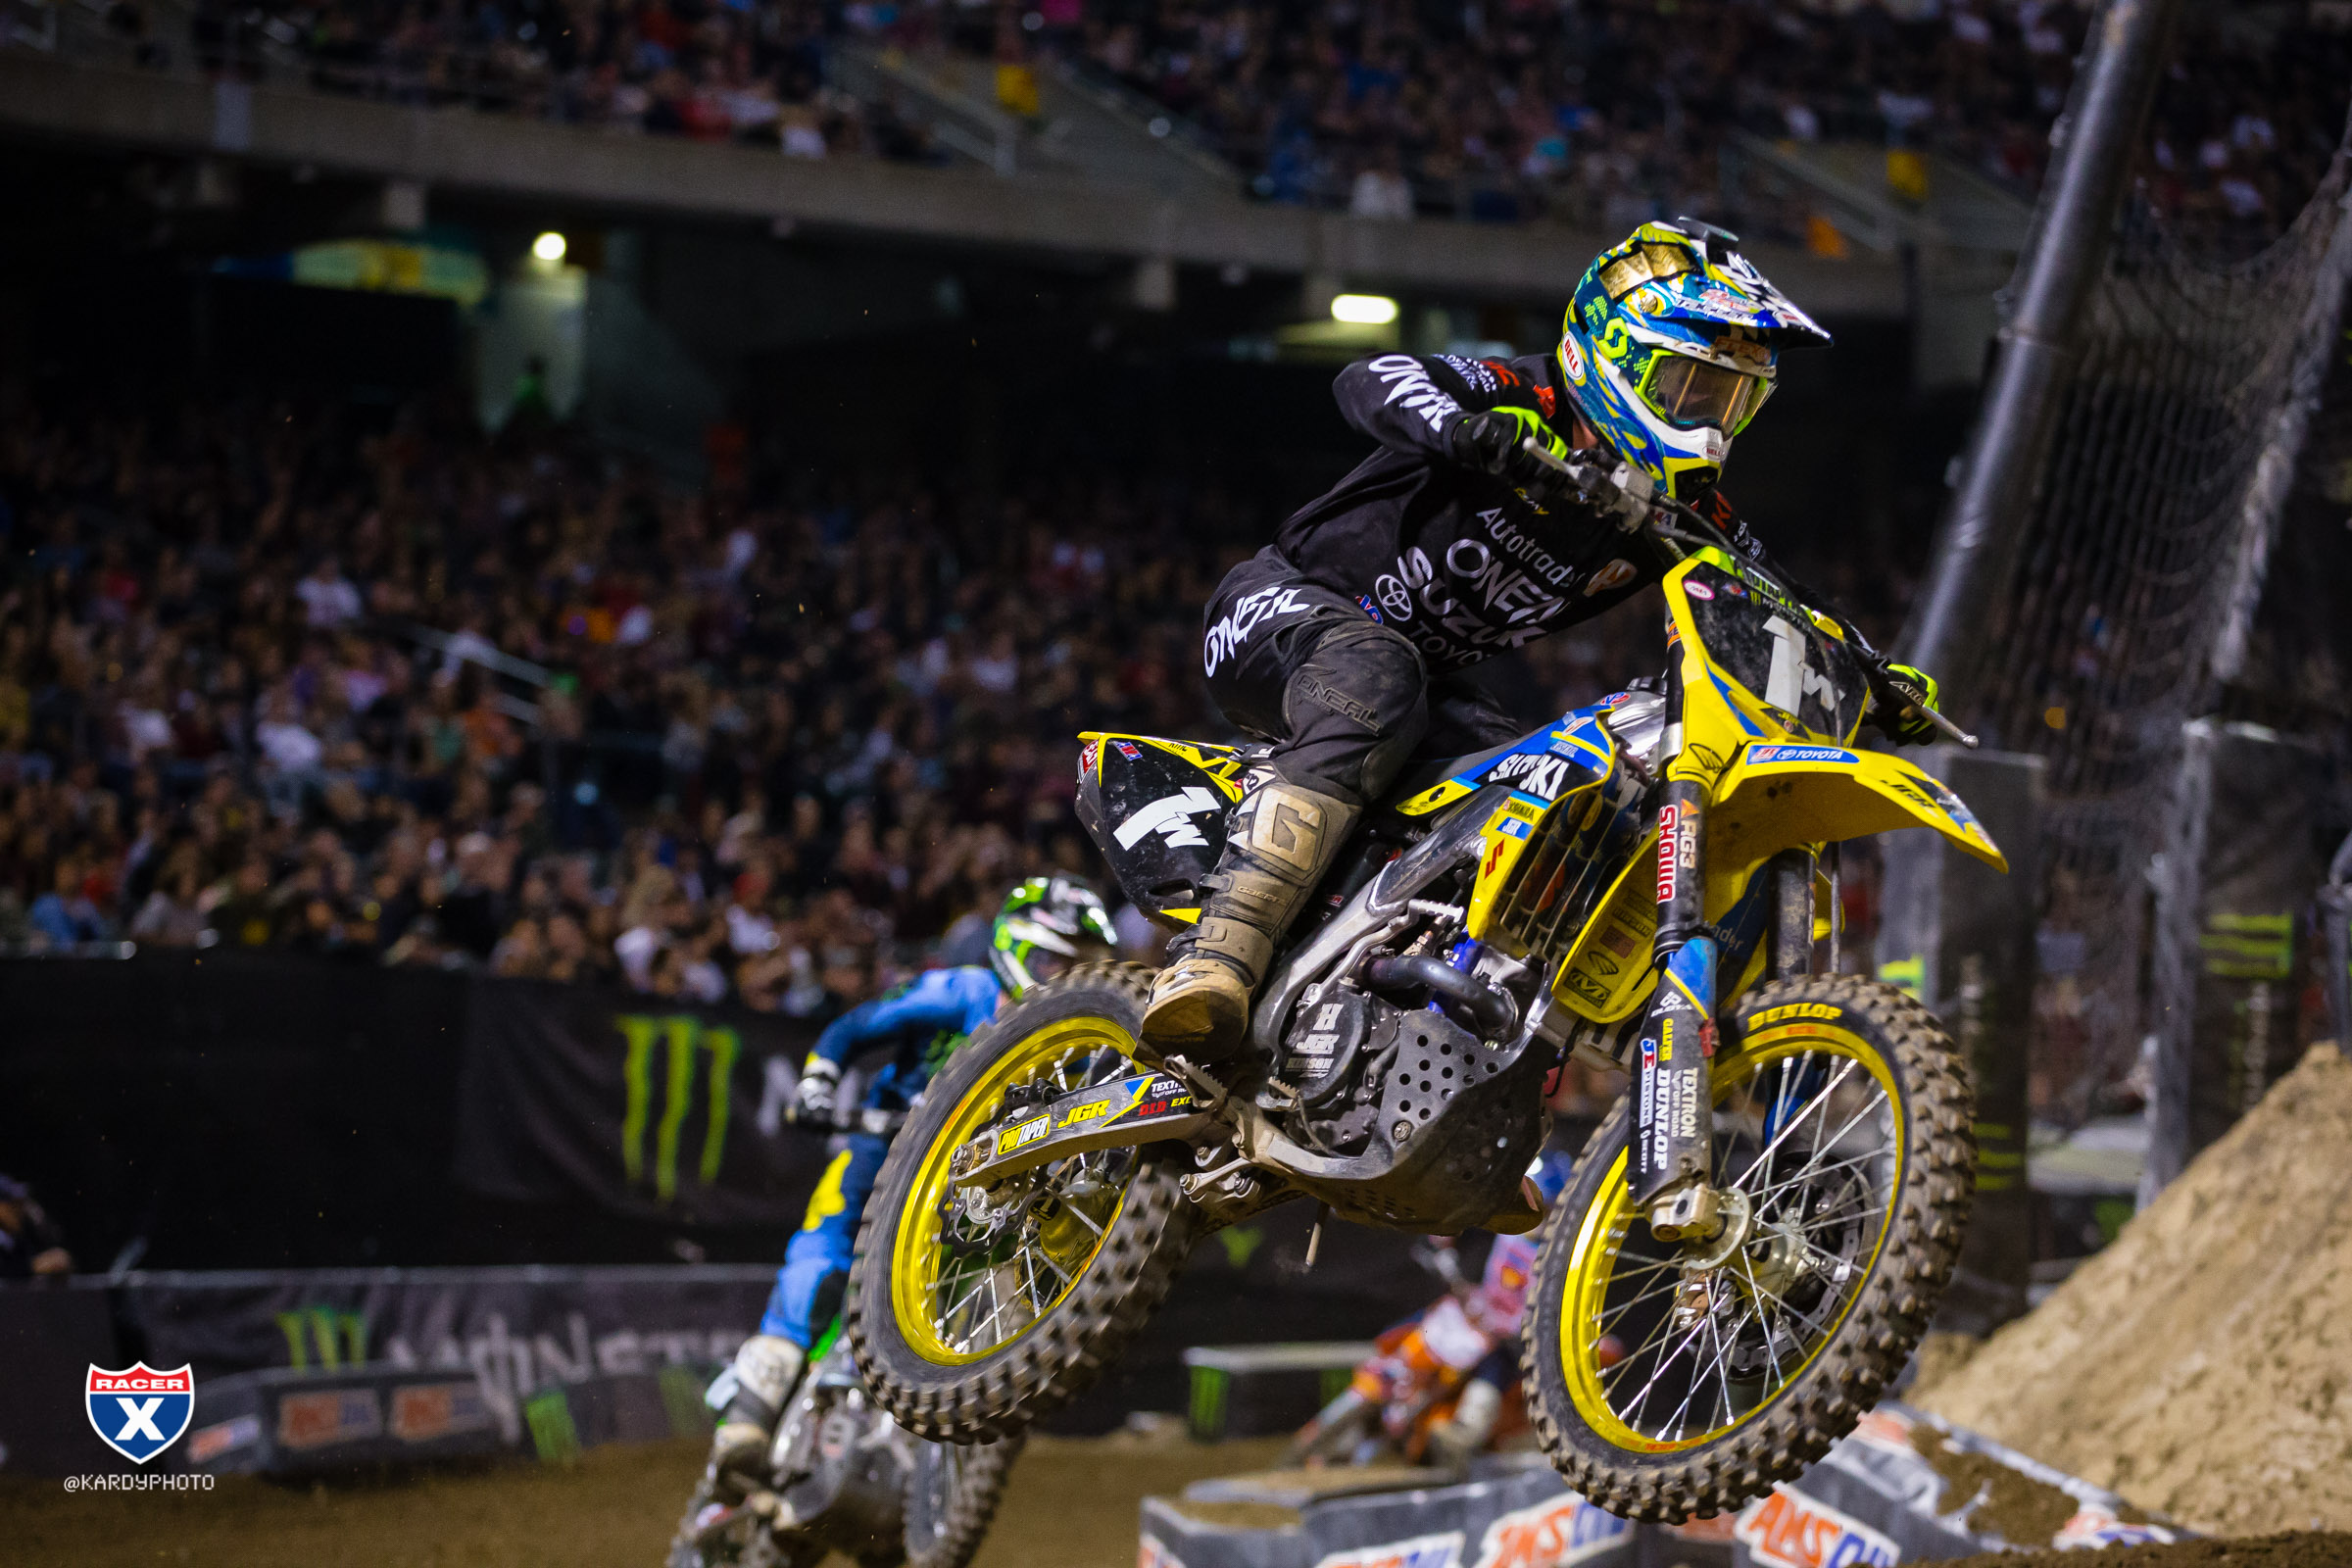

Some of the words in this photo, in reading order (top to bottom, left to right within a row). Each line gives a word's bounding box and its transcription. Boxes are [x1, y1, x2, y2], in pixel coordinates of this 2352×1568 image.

[1565, 338, 1579, 374] BELL
[1397, 546, 1548, 650] SUZUK
[1446, 538, 1567, 624] ONEA
[1408, 620, 1494, 666] TOYO
[1296, 674, 1384, 737] ONEAL
[1794, 750, 1843, 760] TOYOTA
[1656, 805, 1678, 906] SHOWA
[1151, 1081, 1186, 1093] TEXT
[1642, 1069, 1651, 1126] PISTONS
[1671, 1090, 1680, 1106] OFF
[1680, 1067, 1698, 1139] TEXTRON
[1057, 1099, 1111, 1129] JGR
[1654, 1068, 1672, 1170] DUNLOP
[1671, 1106, 1680, 1138] ROAD
[1640, 1139, 1649, 1175] SCOTT
